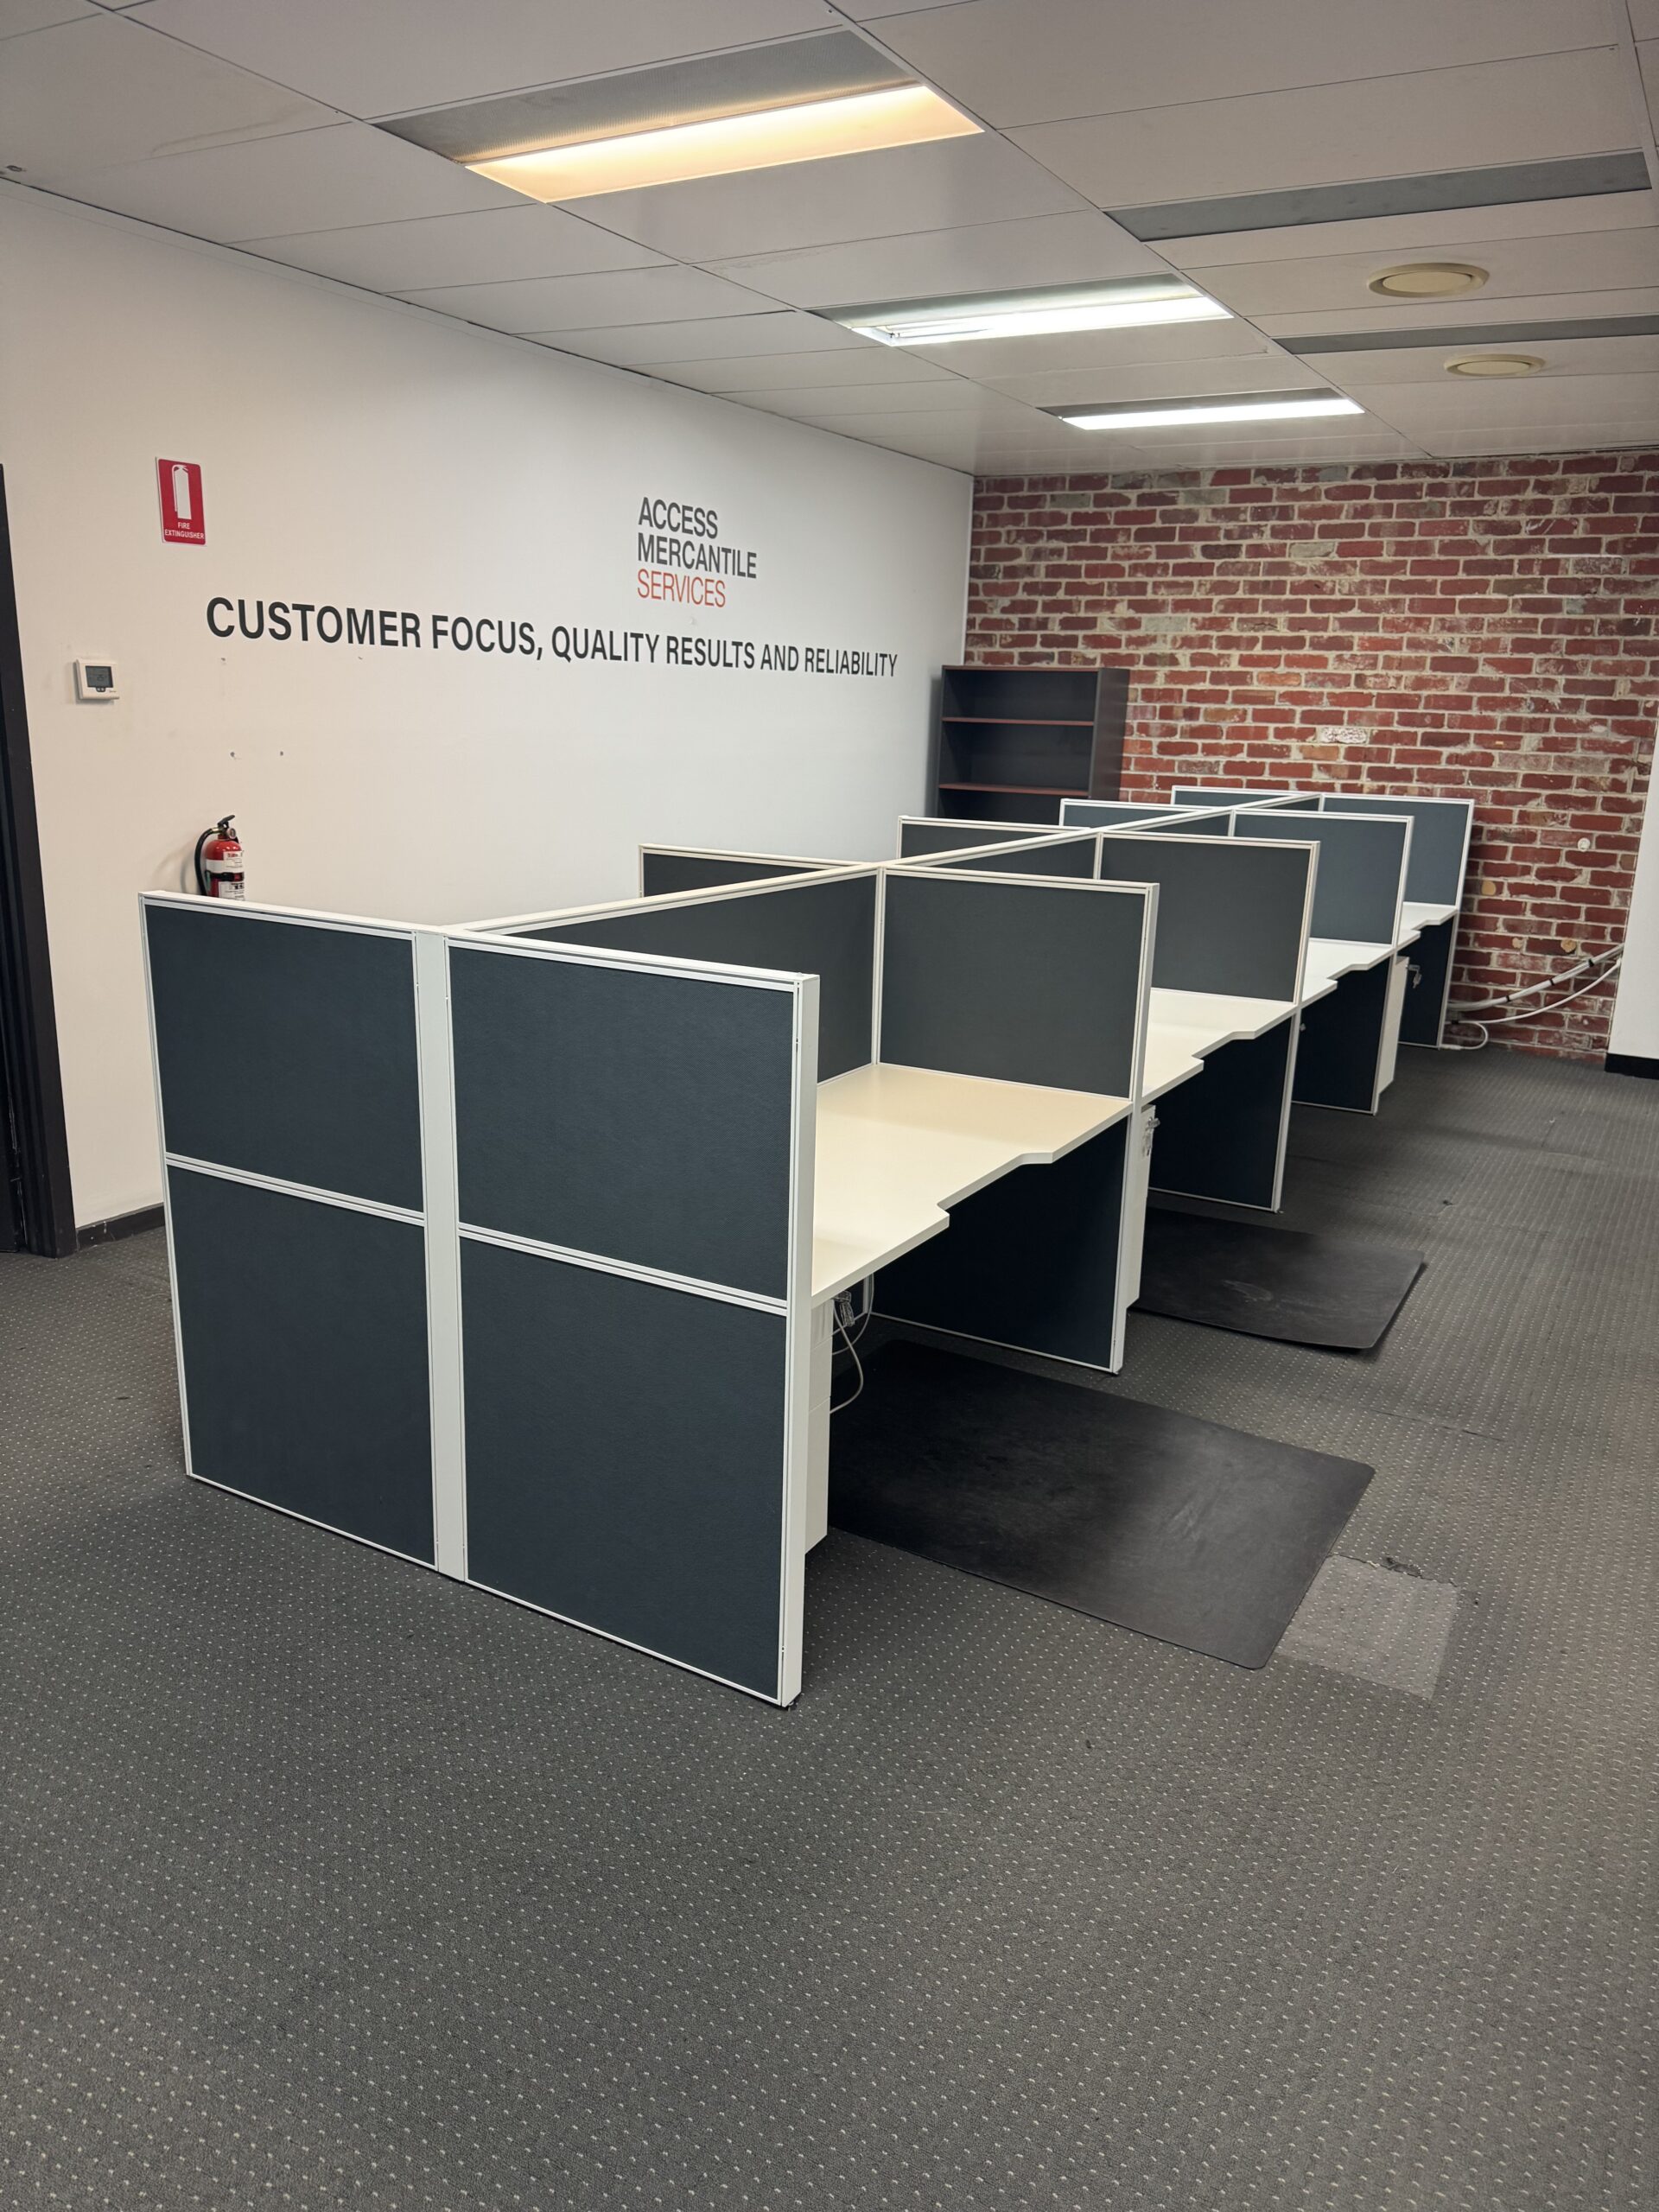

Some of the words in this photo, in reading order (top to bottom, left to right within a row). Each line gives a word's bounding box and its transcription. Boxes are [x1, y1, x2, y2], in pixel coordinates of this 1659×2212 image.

[165, 530, 205, 539] EXTINGUISHER
[638, 496, 719, 540] ACCESS
[637, 531, 758, 580] MERCANTILE
[637, 568, 726, 608] SERVICES
[206, 596, 422, 649] CUSTOMER
[431, 613, 543, 661] FOCUS,
[551, 625, 660, 664] QUALITY
[666, 635, 755, 670] RESULTS
[760, 643, 800, 672] AND
[804, 646, 899, 677] RELIABILITY
